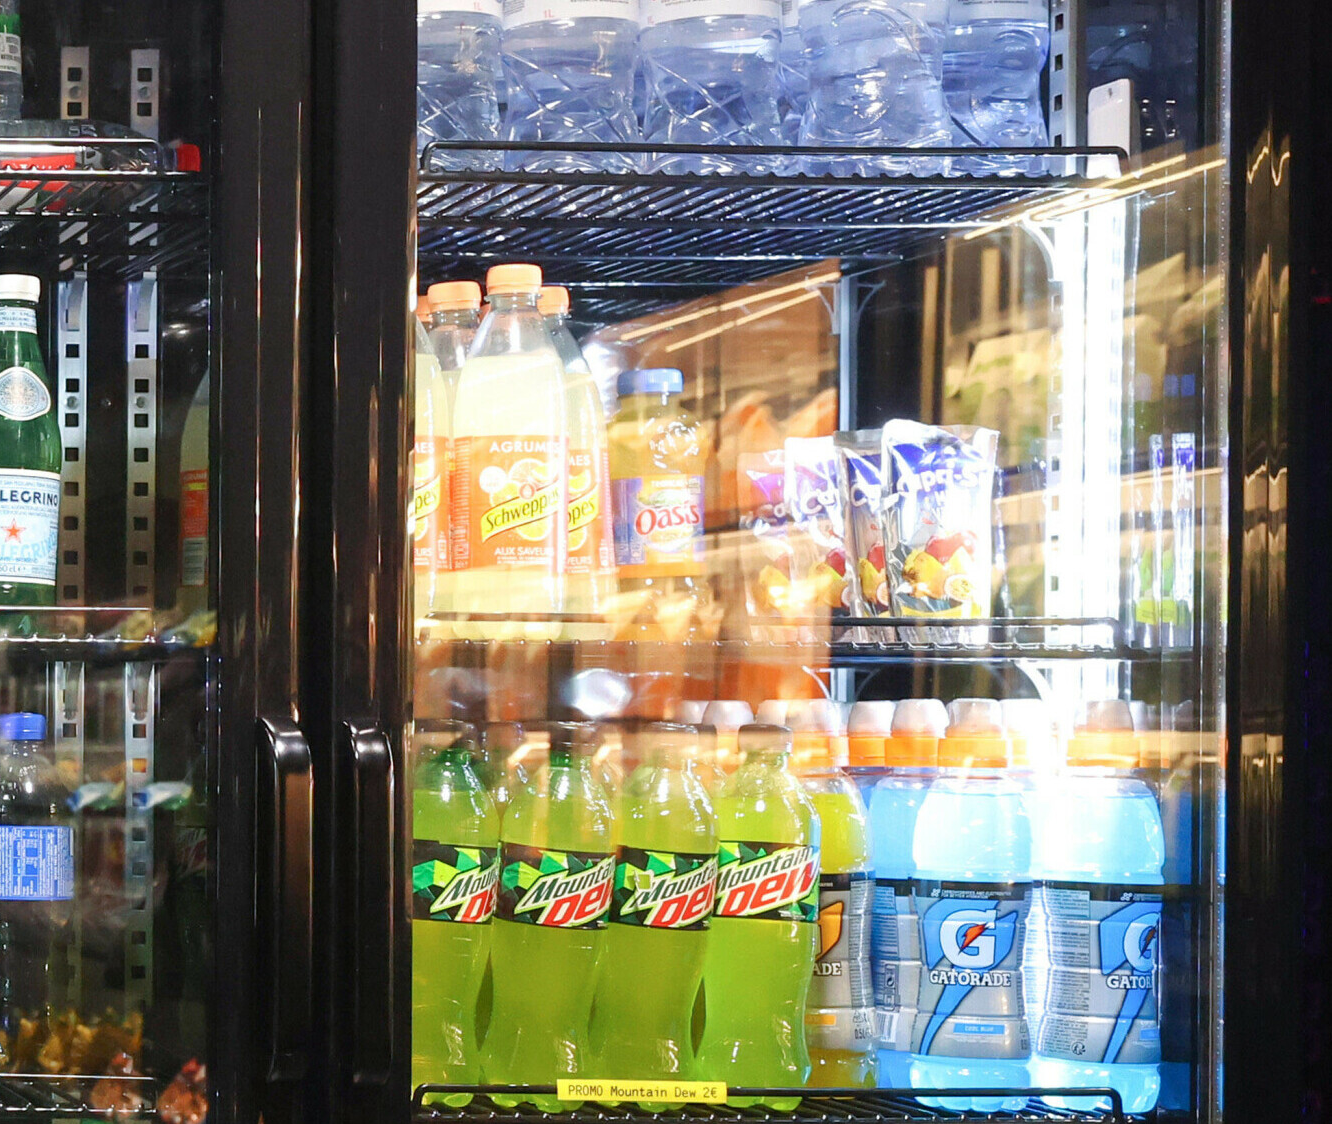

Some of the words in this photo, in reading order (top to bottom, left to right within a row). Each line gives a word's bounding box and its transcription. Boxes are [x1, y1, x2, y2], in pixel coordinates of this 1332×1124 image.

[635, 502, 700, 536] Oasis
[494, 547, 514, 557] AUX
[940, 909, 997, 969] G
[929, 970, 1011, 986] GATORADE
[568, 1085, 603, 1097] PROMO
[611, 1085, 670, 1097] Mountain
[674, 1085, 696, 1097] Dew
[703, 1085, 717, 1097] 2€
